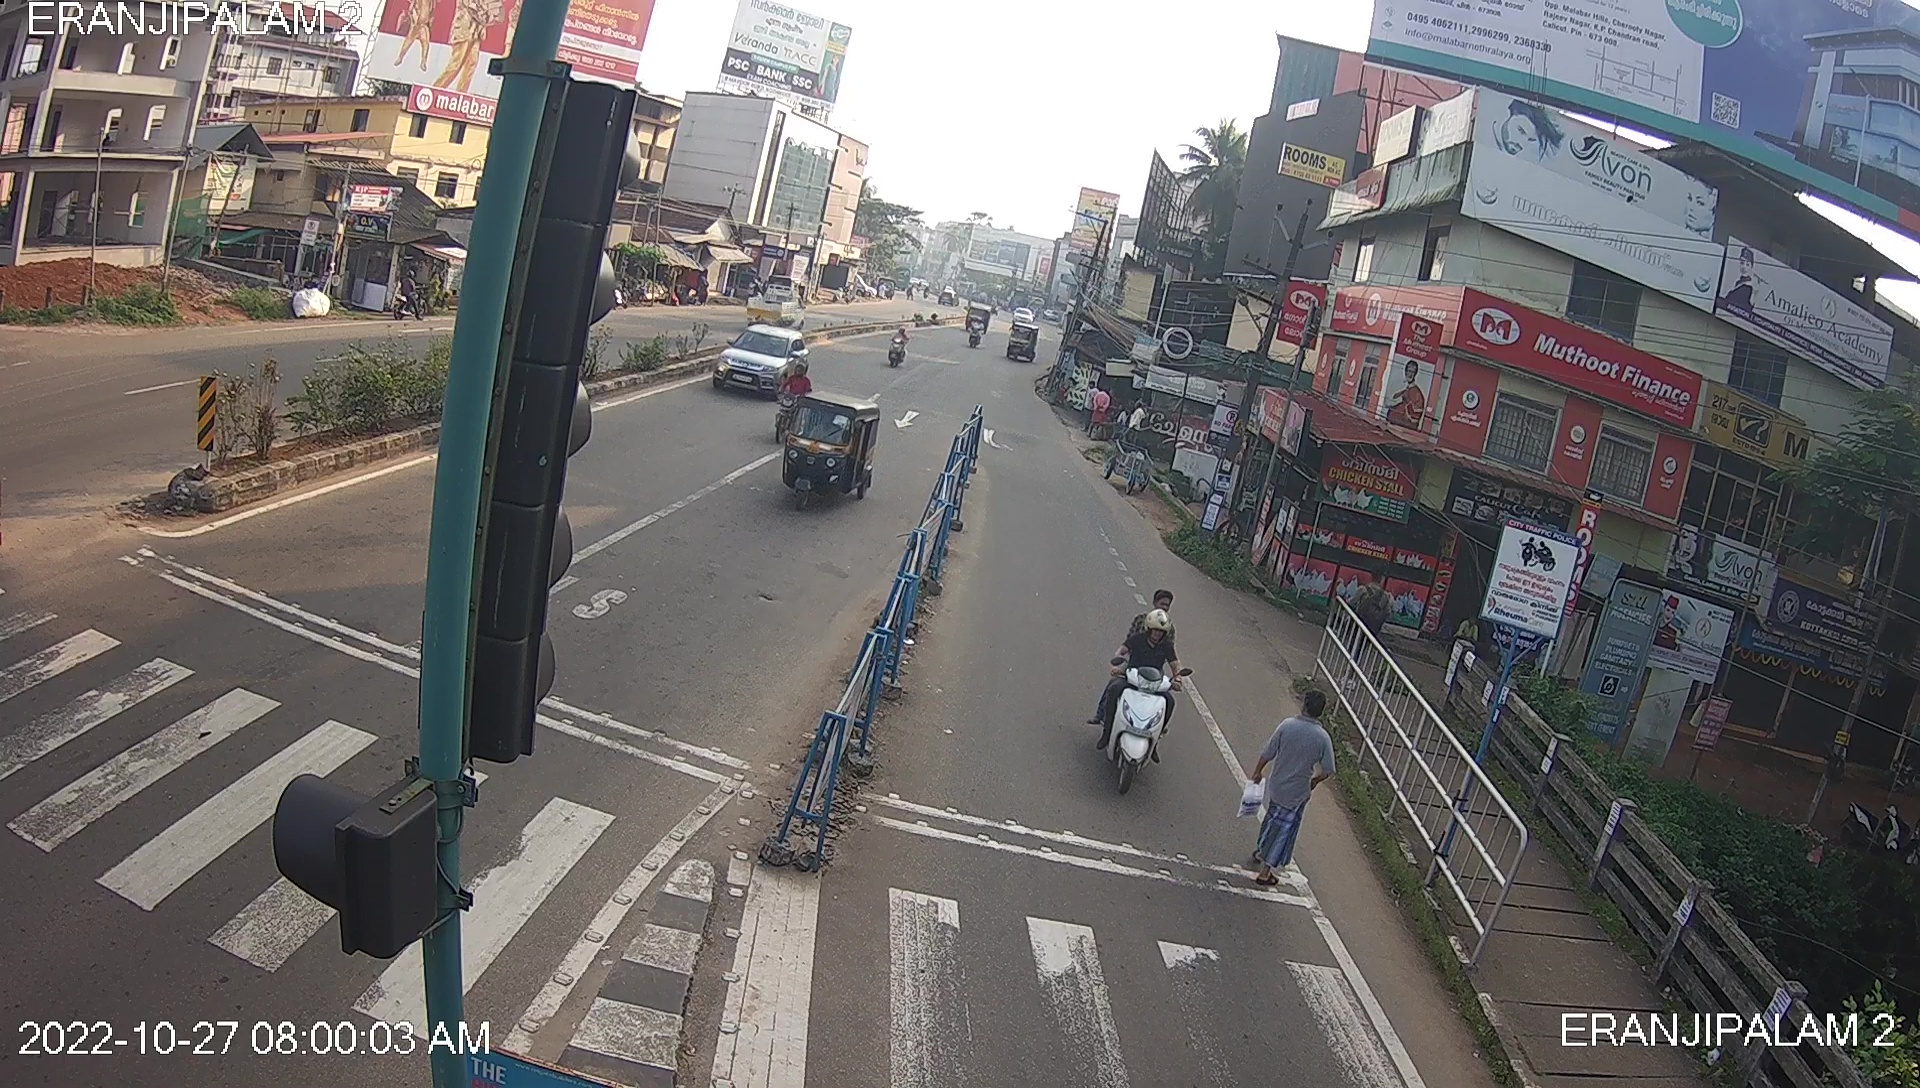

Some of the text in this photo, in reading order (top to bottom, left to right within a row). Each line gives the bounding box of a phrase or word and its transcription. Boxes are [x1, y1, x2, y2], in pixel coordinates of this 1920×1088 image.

[1406, 12, 1429, 25] 0495
[1543, 10, 1568, 23] Rajeev
[1569, 17, 1592, 30] Nagar,
[1607, 28, 1641, 44] Chandran
[1562, 5, 1591, 18] Malabar
[1593, 13, 1611, 25] Hills,
[1644, 27, 1667, 42] Nagar,
[734, 32, 779, 54] Veranda
[1570, 27, 1582, 37] Pin
[1588, 32, 1602, 43] 673
[727, 56, 750, 72] PSC
[756, 65, 787, 82] BANK
[791, 75, 813, 90] SSC
[763, 79, 792, 91] COACHING
[435, 95, 494, 119] malabar
[1284, 146, 1327, 170] ROOMS
[1584, 170, 1603, 182] FAMILY
[1603, 177, 1623, 191] BEAUTY
[1764, 289, 1825, 330] Amalieo
[1826, 322, 1884, 365] Academy
[1403, 337, 1433, 353] Muthoot
[1413, 335, 1425, 343] The
[1405, 345, 1428, 357] Group
[1533, 332, 1620, 379] Muthoot
[1621, 363, 1691, 407] Finance
[1328, 466, 1375, 489] CHICKEN
[1375, 477, 1405, 496] STALL
[1474, 494, 1512, 509] CALICUT
[1508, 519, 1577, 545] CITY TRAFFIC POLICE
[1347, 544, 1372, 556] CHICKEN
[1372, 549, 1389, 559] STALL
[1715, 550, 1763, 585] Avon
[1493, 607, 1528, 624] Rheuma
[471, 1056, 507, 1085] THE
